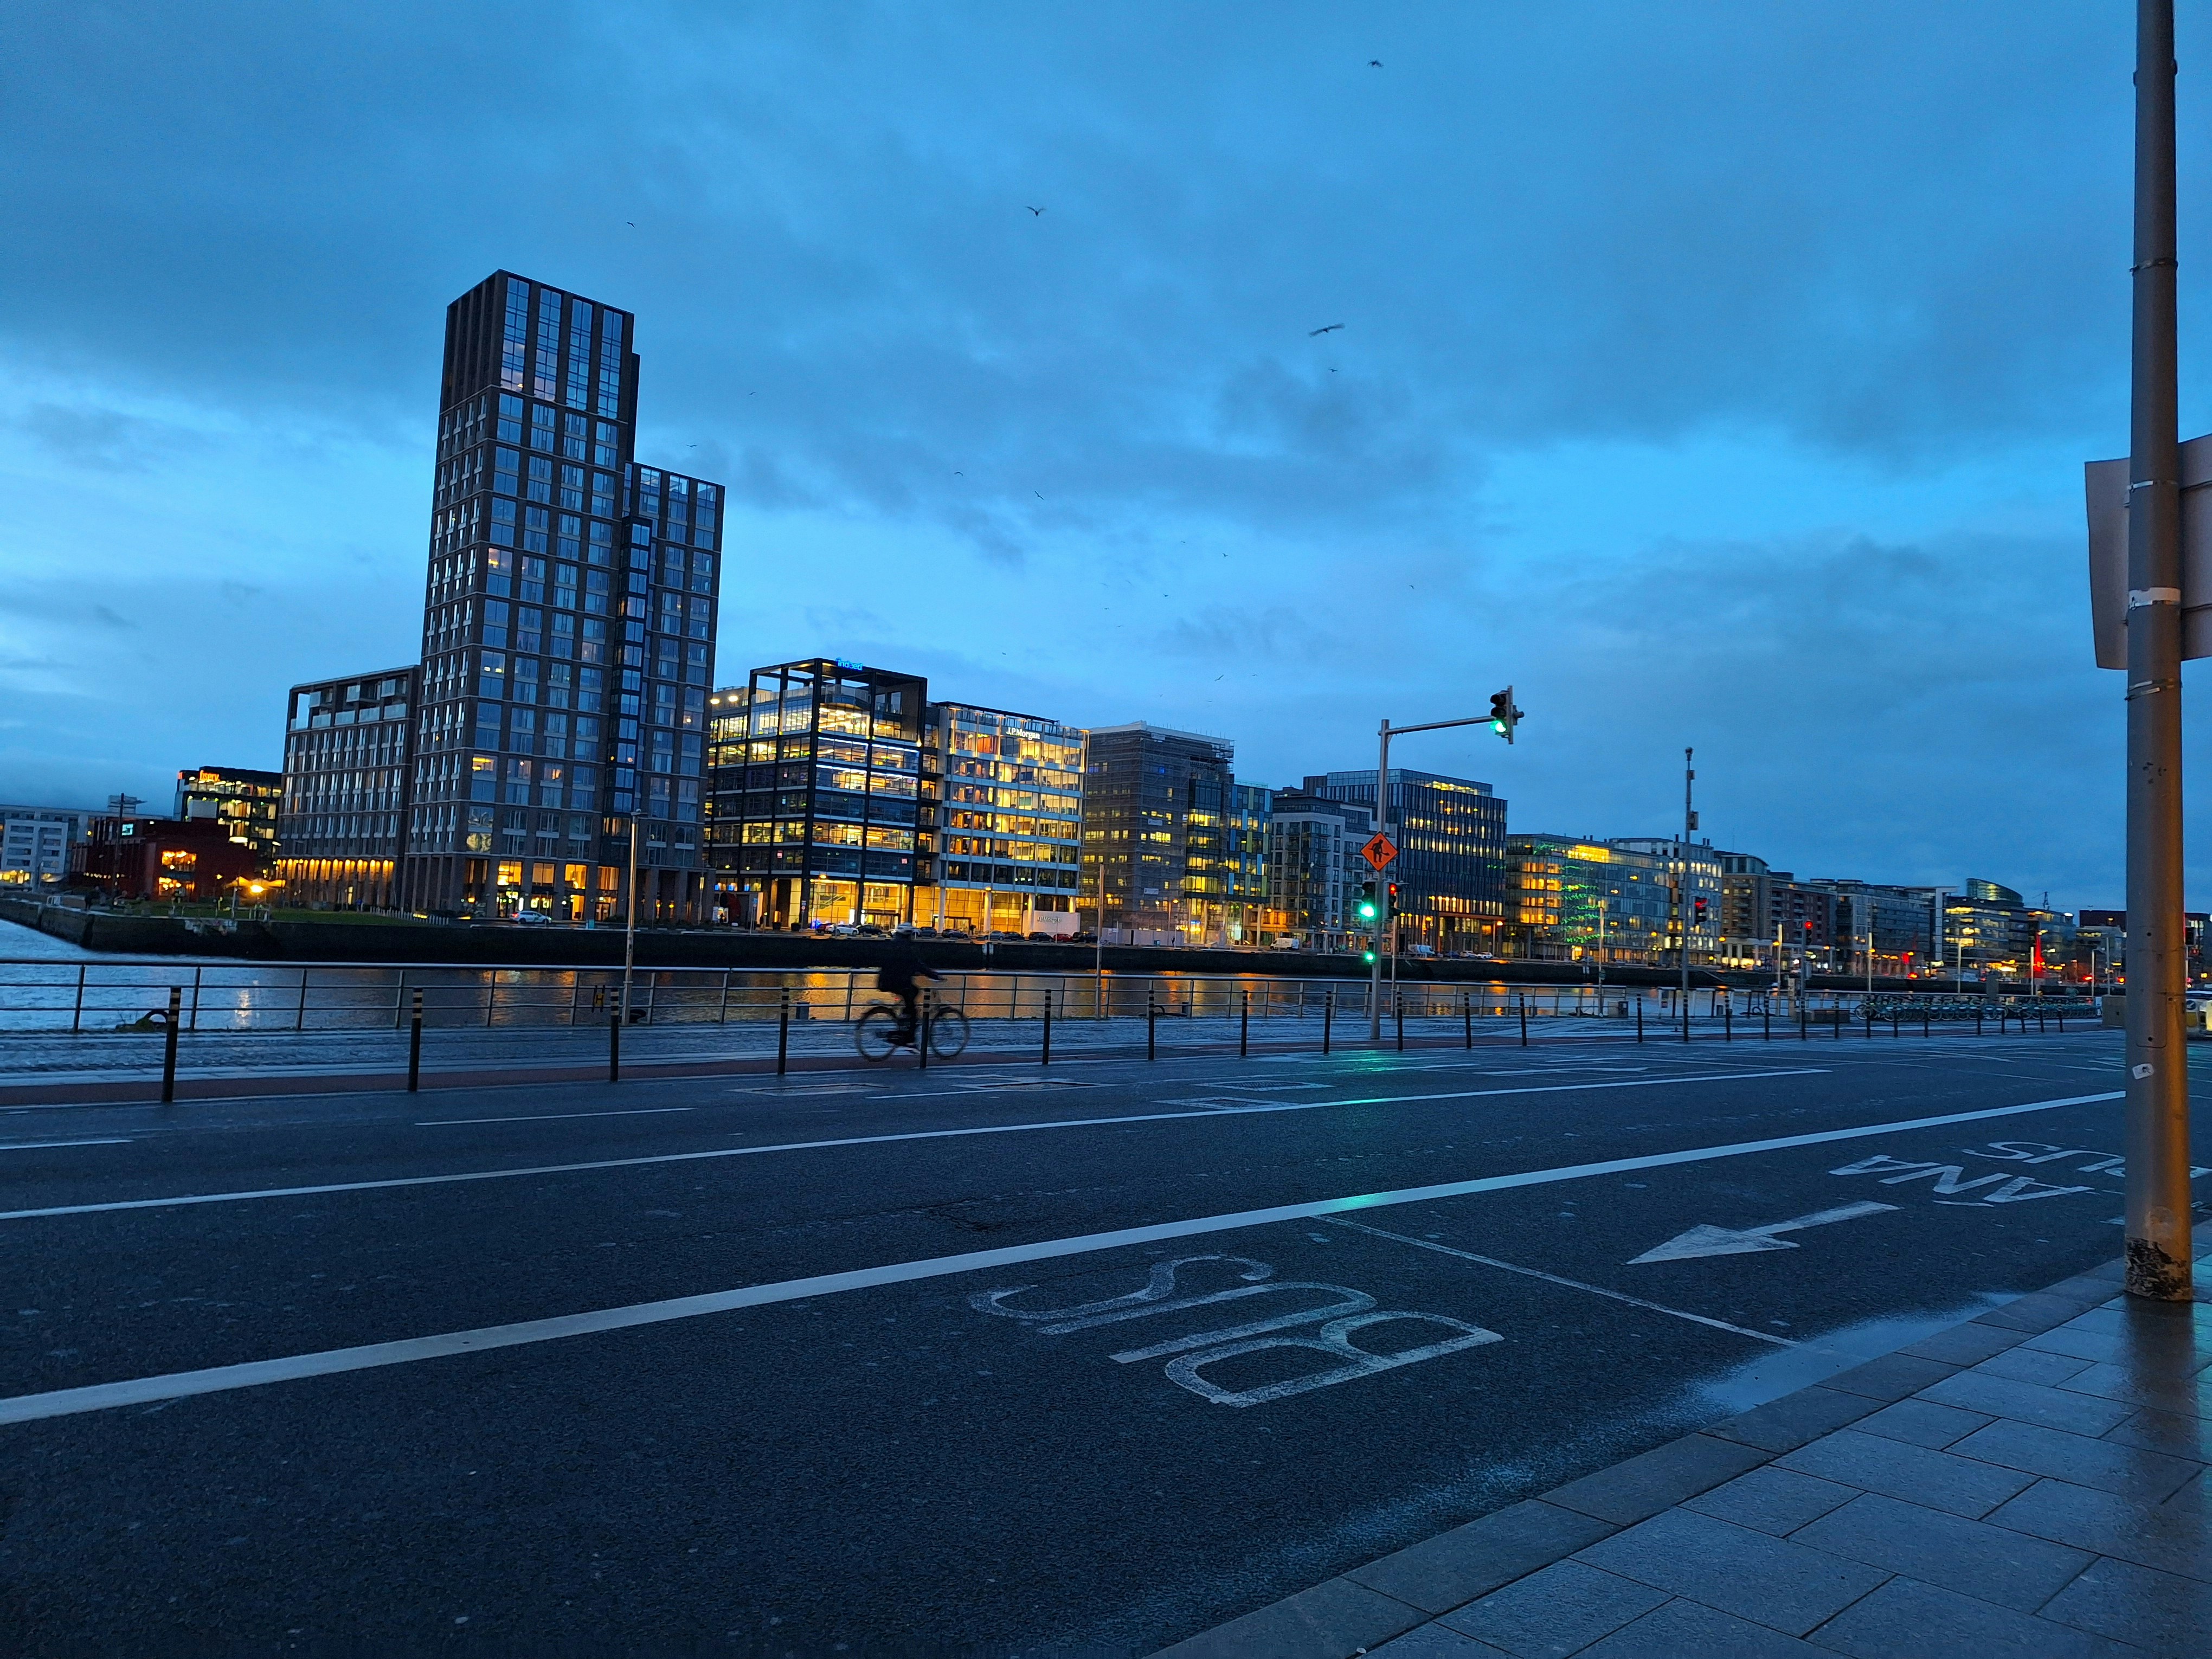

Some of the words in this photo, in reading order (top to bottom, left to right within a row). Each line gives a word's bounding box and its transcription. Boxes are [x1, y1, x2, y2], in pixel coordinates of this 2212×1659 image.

[836, 658, 862, 671] indeed
[1006, 727, 1040, 740] J.P.Morgan
[969, 1254, 1504, 1408] BUS
